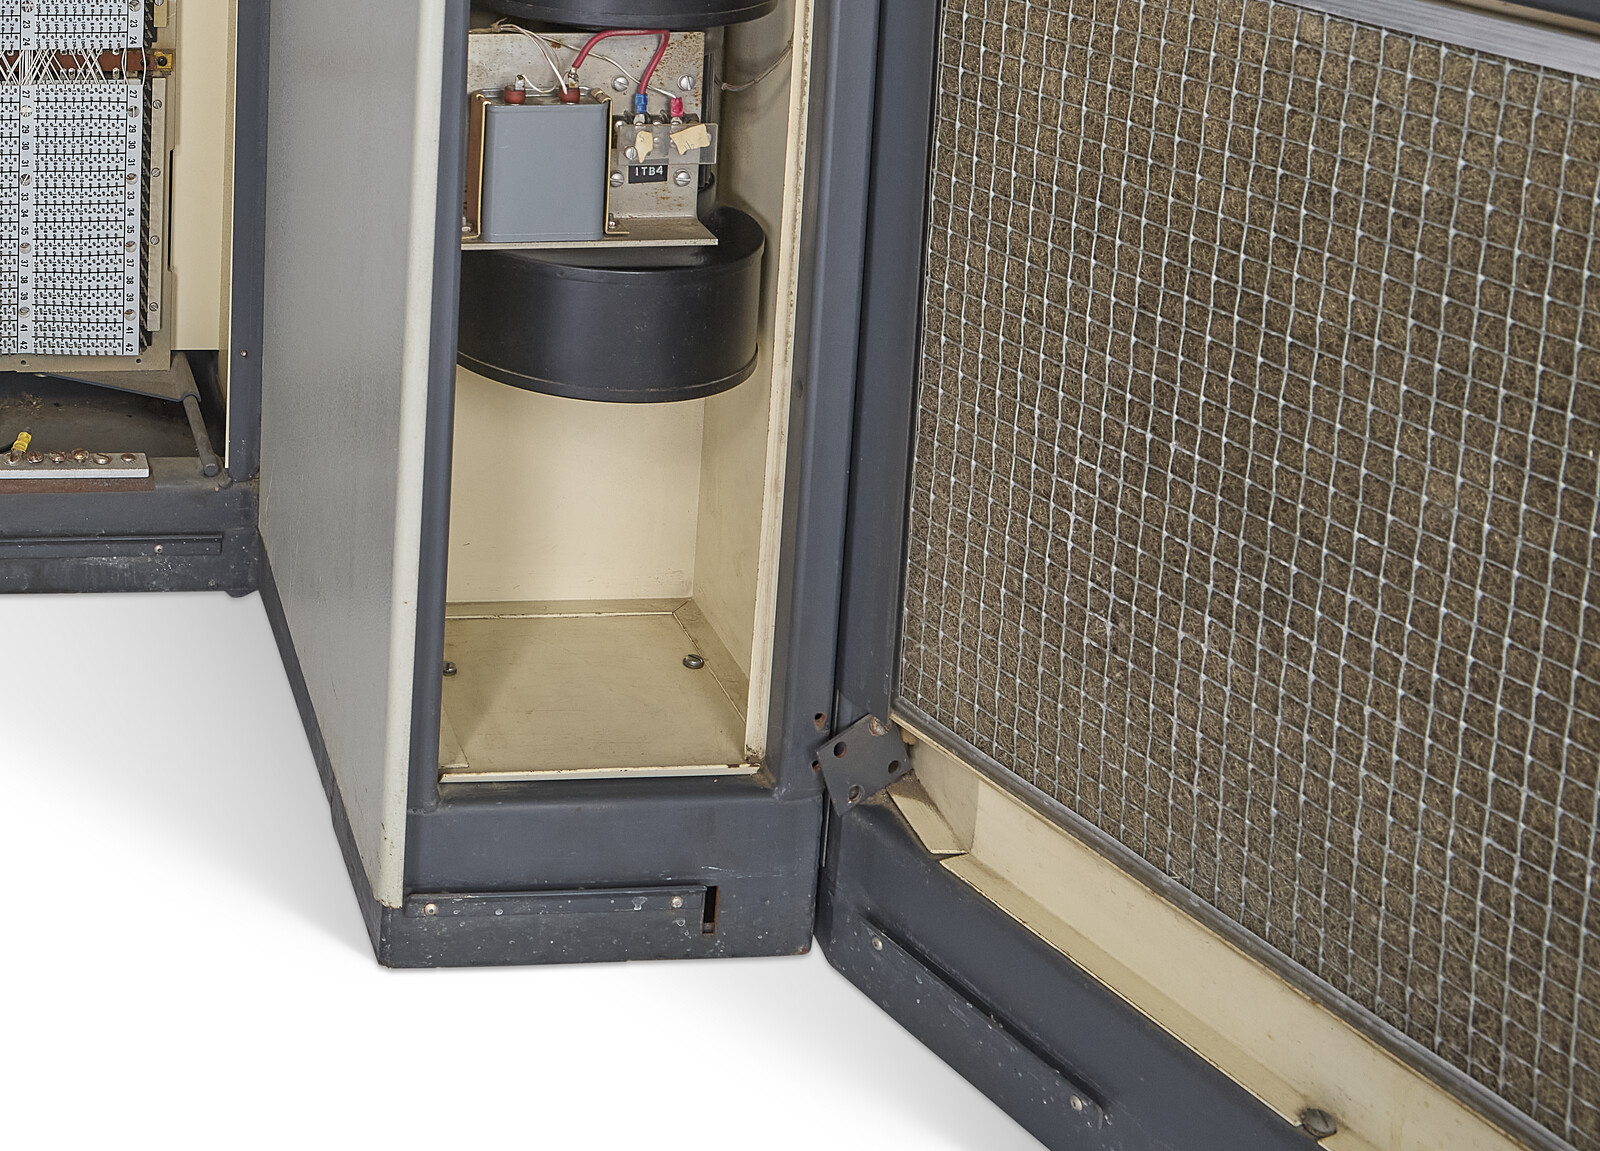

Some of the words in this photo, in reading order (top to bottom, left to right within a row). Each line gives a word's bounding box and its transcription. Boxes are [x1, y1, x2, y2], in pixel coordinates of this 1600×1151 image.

[23, 20, 31, 29] 23
[130, 19, 138, 28] 23
[23, 37, 30, 46] 24
[129, 36, 137, 44] 24
[22, 90, 30, 98] 27
[129, 90, 137, 98] 27
[22, 125, 30, 134] 29
[128, 125, 136, 133] 29
[22, 141, 30, 150] 30
[128, 141, 136, 149] 30
[21, 192, 29, 201] 33
[127, 191, 135, 200] 33
[21, 209, 29, 218] 34
[127, 208, 135, 216] 34
[21, 227, 29, 235] 35
[127, 225, 135, 234] 35
[126, 259, 134, 267] 37
[20, 276, 28, 284] 38
[126, 276, 134, 284] 38
[20, 292, 28, 300] 39
[126, 293, 134, 302] 39
[126, 326, 134, 334] 41
[20, 341, 28, 350] 42
[125, 343, 133, 352] 42
